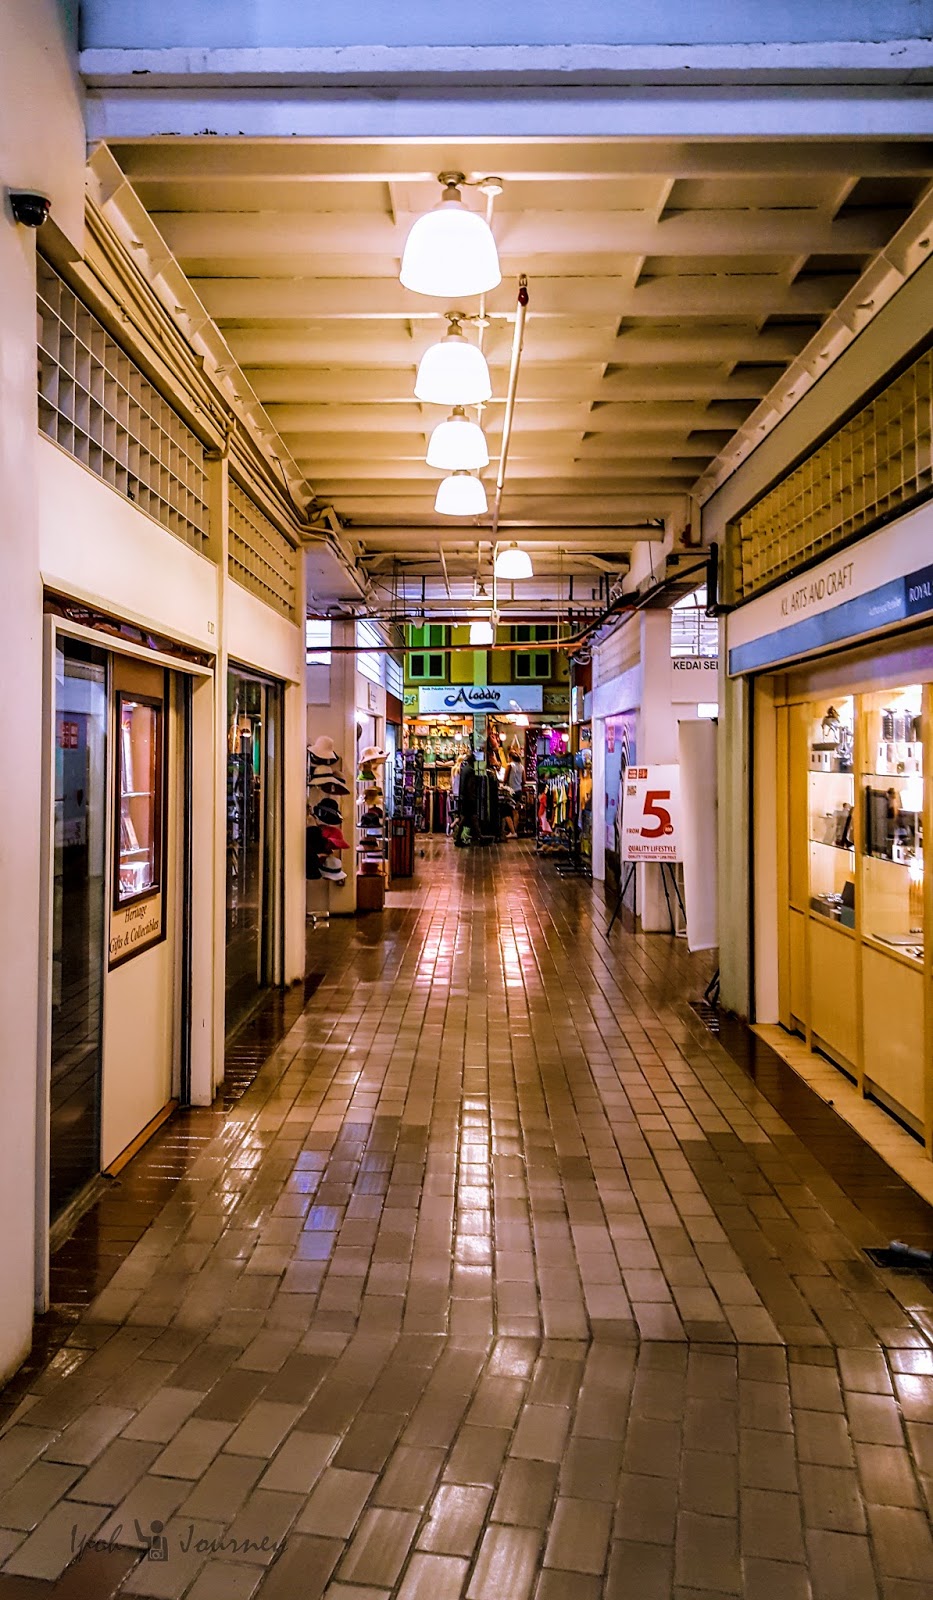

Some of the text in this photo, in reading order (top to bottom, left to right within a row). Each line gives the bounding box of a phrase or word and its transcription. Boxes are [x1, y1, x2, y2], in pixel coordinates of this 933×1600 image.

[791, 587, 807, 612] ARTS
[808, 578, 825, 605] AND
[827, 562, 854, 596] CRAFT
[909, 581, 932, 602] ROYAL
[673, 661, 702, 670] KEDAI
[444, 687, 501, 709] Aladdin
[640, 790, 671, 838] 5
[110, 918, 159, 955] Gifts & Collectibles
